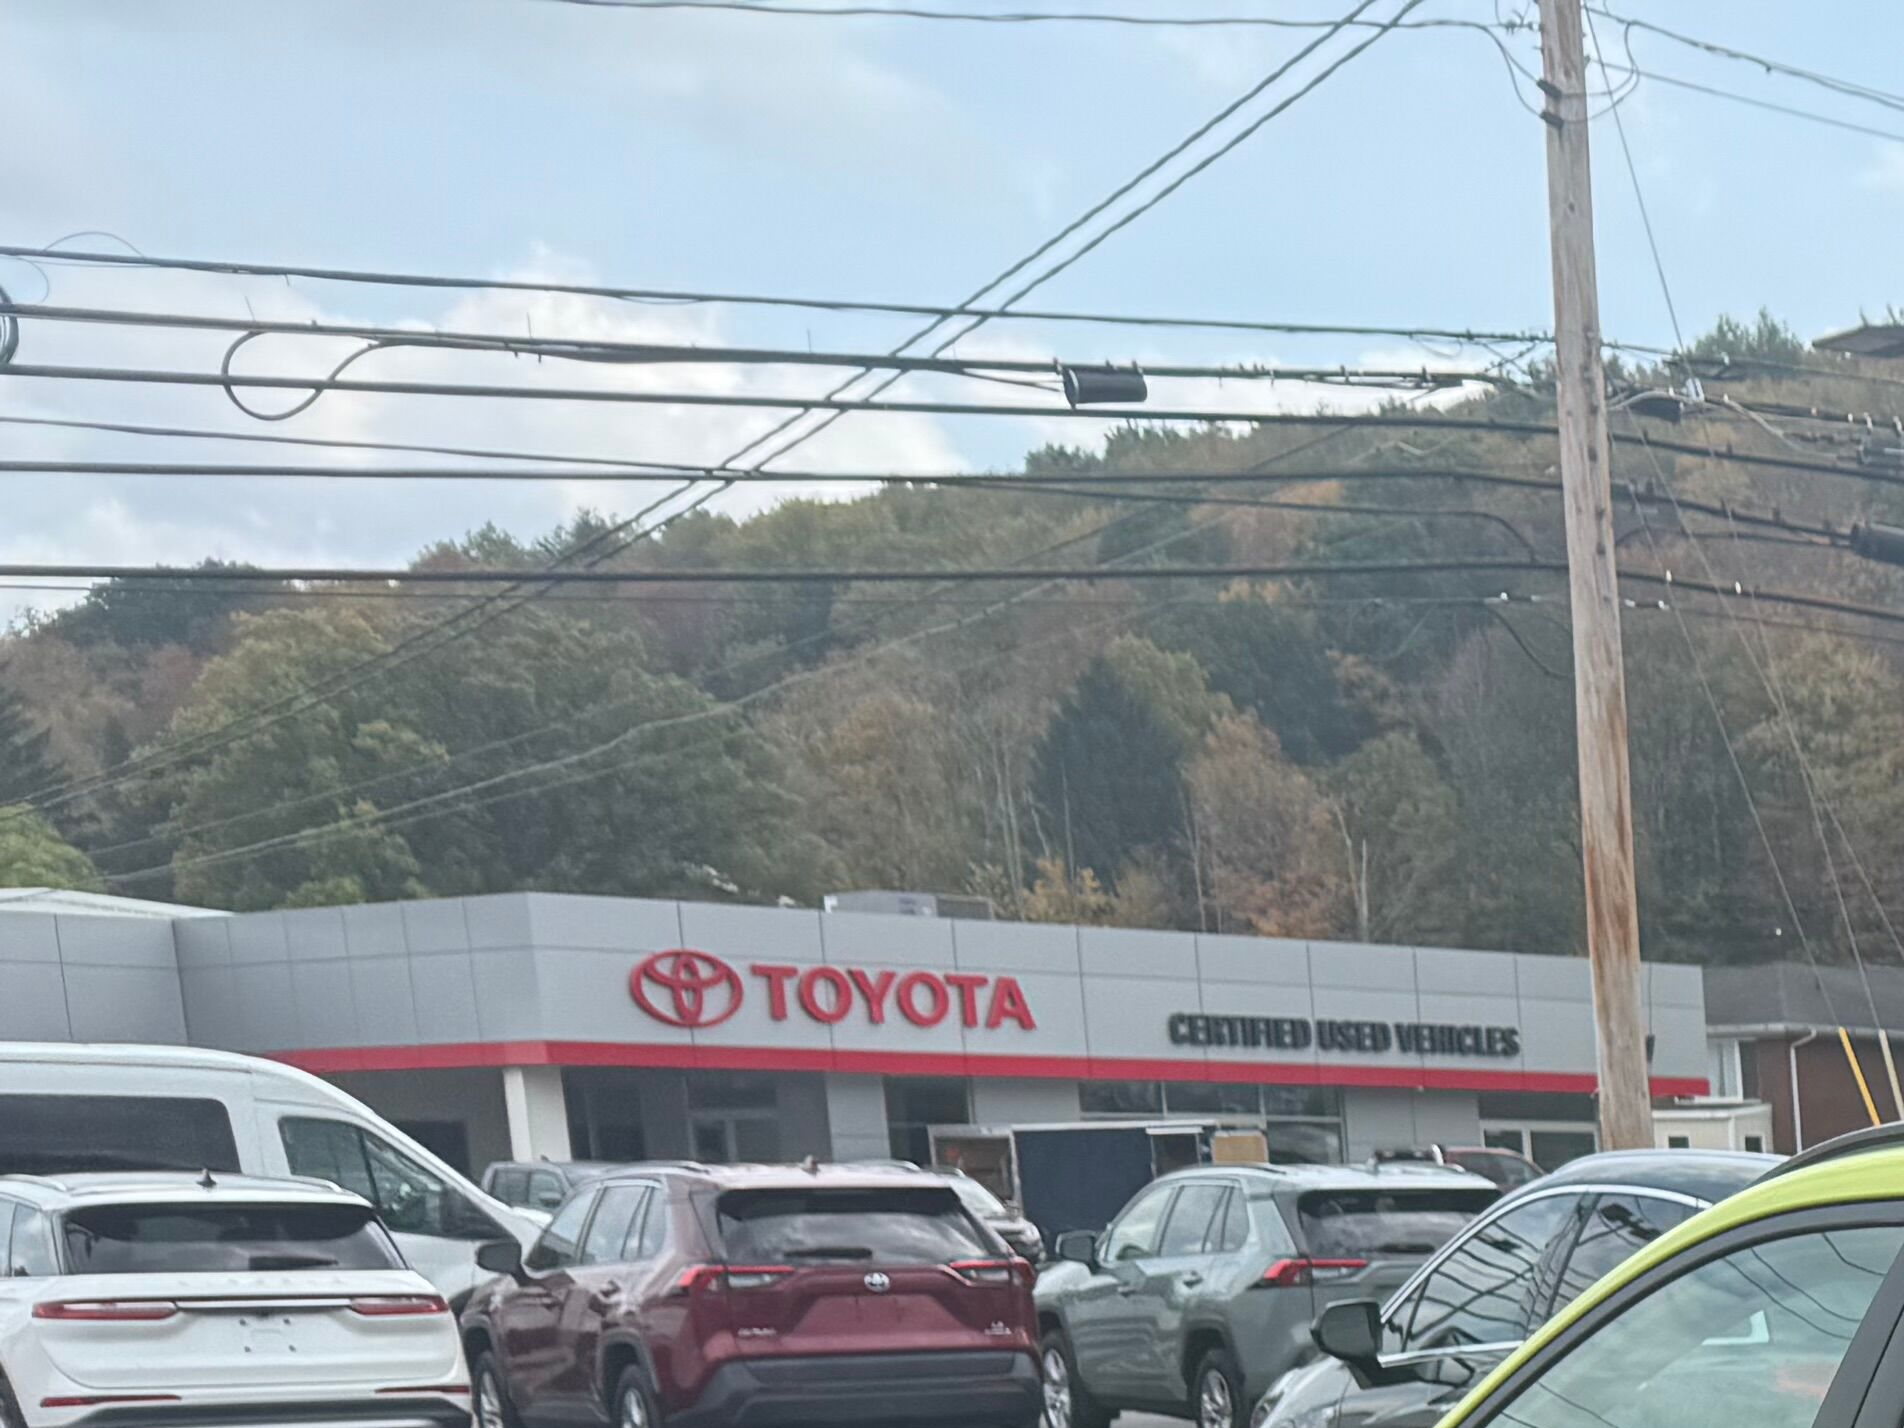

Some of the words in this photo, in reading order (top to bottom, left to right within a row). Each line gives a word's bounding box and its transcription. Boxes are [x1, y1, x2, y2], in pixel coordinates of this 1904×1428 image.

[751, 964, 1037, 1031] TOYOTA
[1168, 1013, 1312, 1050] CERTIFIED
[1316, 1019, 1392, 1052] USED
[1394, 1022, 1521, 1058] VEHICLES
